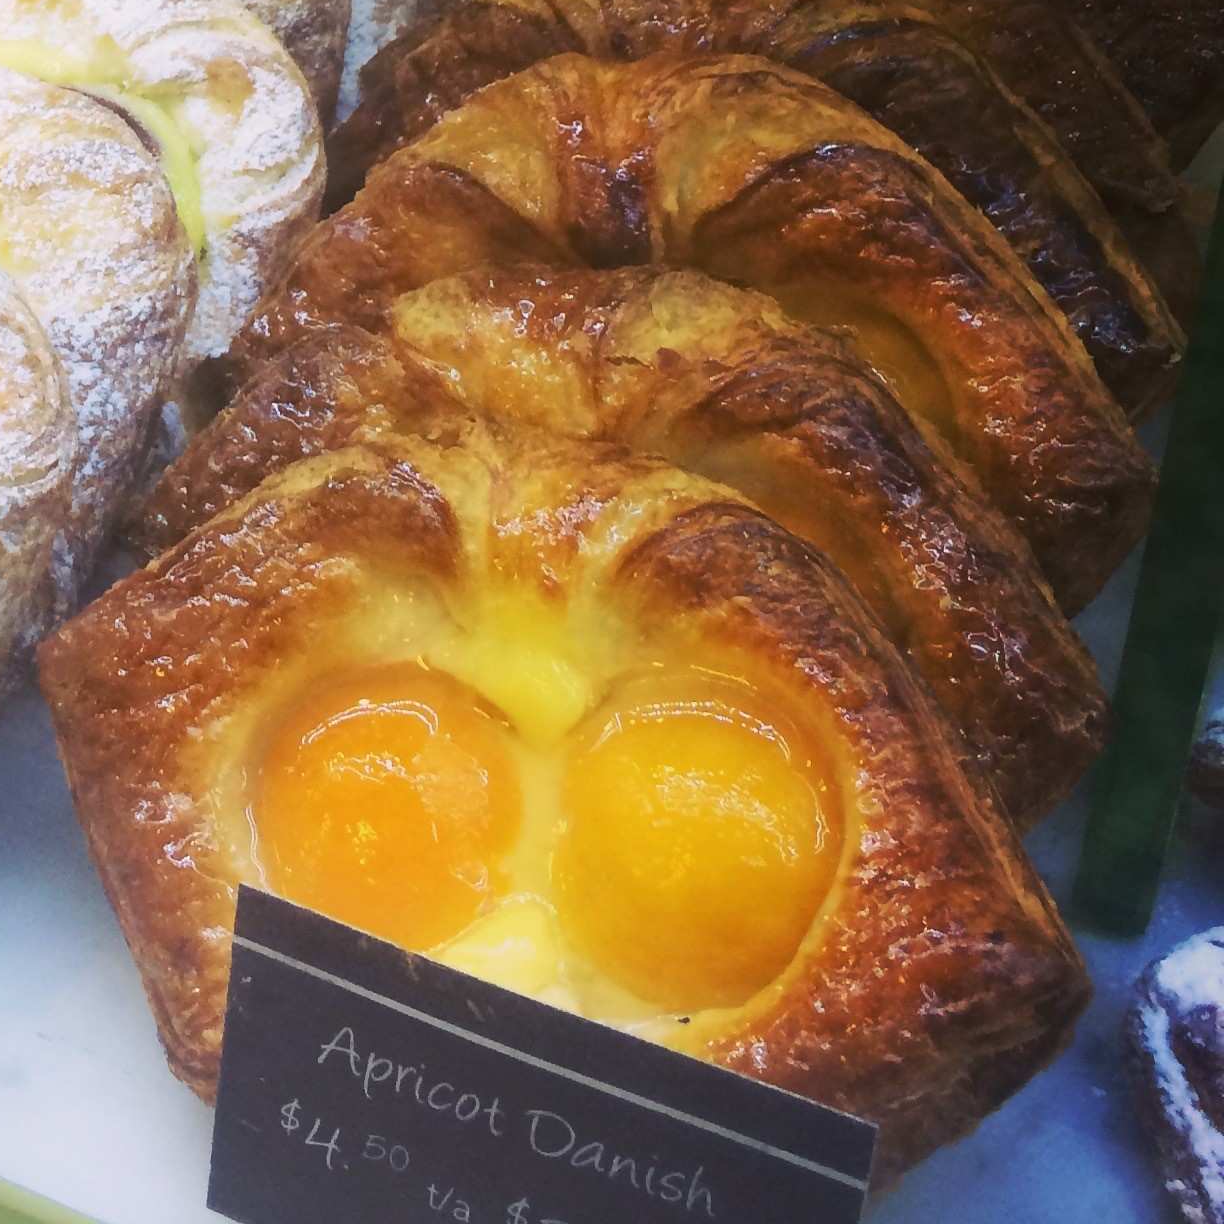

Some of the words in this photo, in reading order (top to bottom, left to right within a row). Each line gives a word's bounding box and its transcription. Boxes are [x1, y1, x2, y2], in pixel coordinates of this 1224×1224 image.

[279, 1099, 411, 1171] $4.50
[427, 1182, 471, 1224] t/a
[317, 1026, 505, 1137] Apricot
[526, 1109, 717, 1217] Danish
